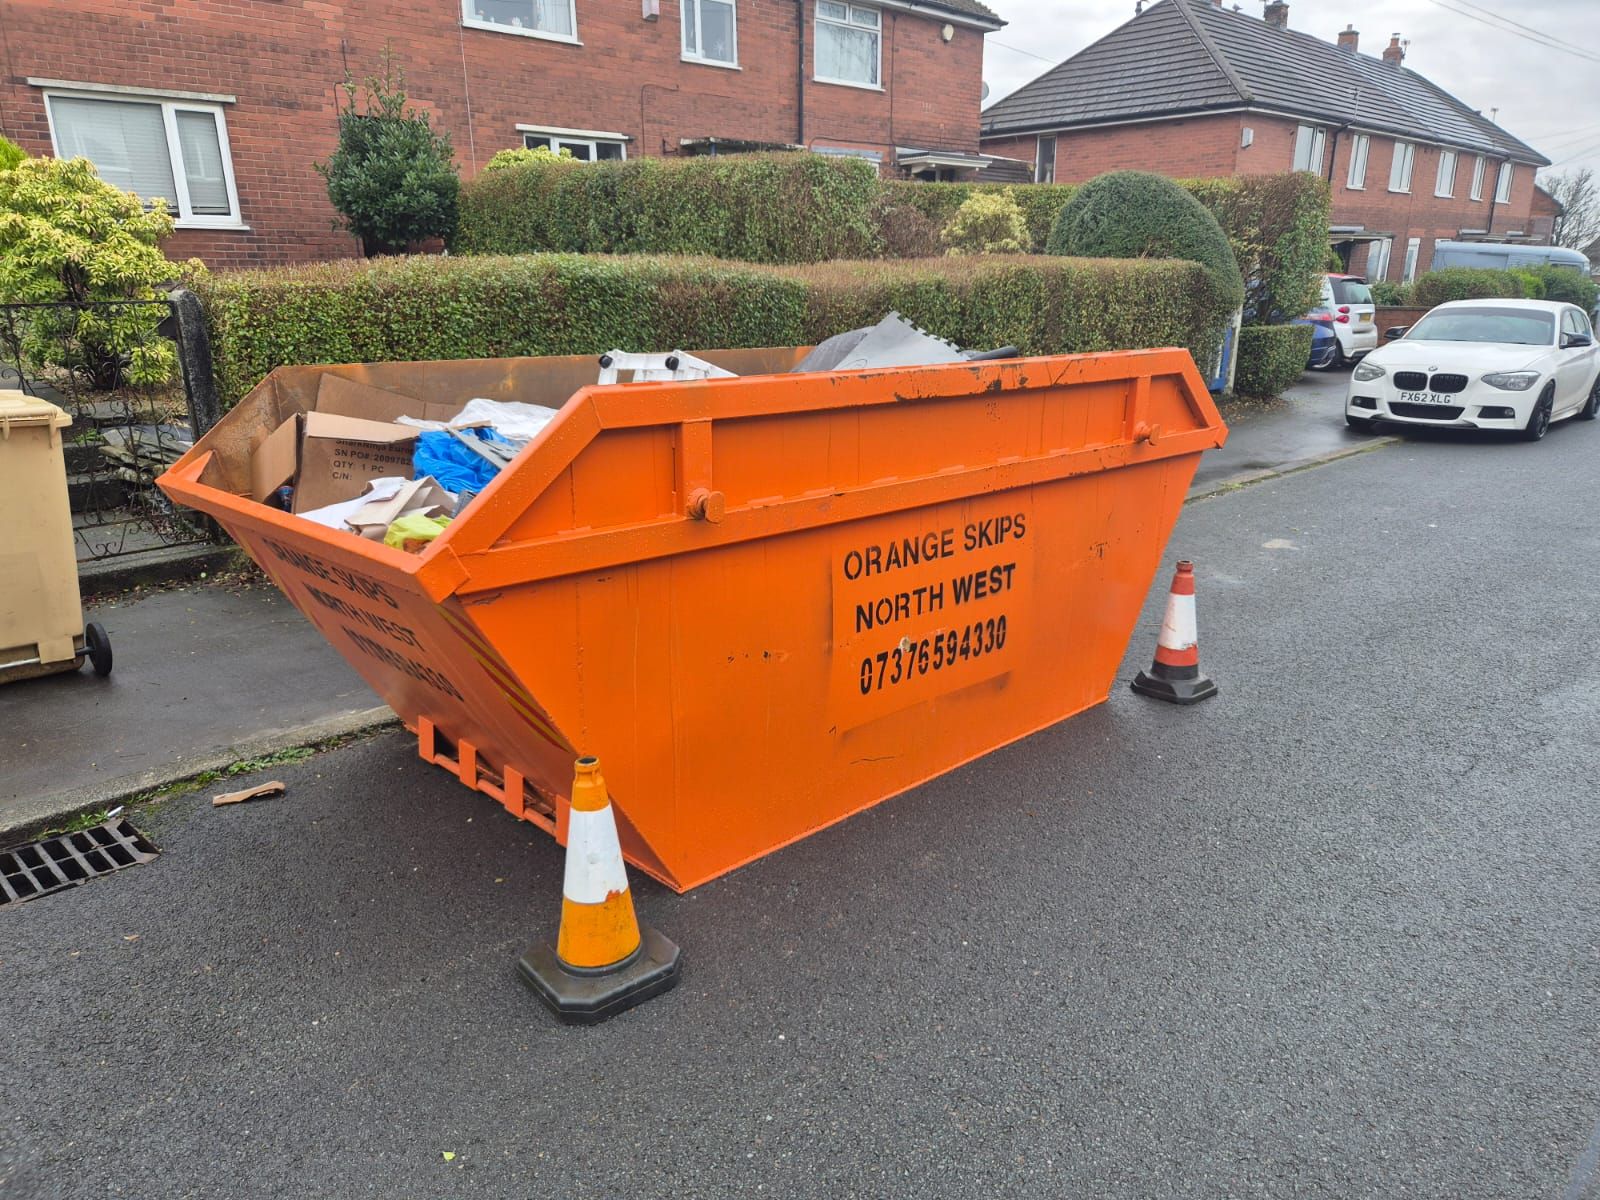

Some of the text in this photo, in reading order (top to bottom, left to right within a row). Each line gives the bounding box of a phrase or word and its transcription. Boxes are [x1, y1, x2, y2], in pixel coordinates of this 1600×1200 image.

[1401, 392, 1451, 404] FX62 XLG
[335, 448, 348, 457] SN
[371, 465, 385, 474] PC
[332, 471, 353, 481] C/N:
[844, 513, 1026, 580] ORANGE SKIPS
[331, 566, 399, 609] SKIPS
[856, 562, 1016, 633] NORTH WEST
[359, 607, 425, 652] WEST
[860, 614, 1007, 695] 07376594330
